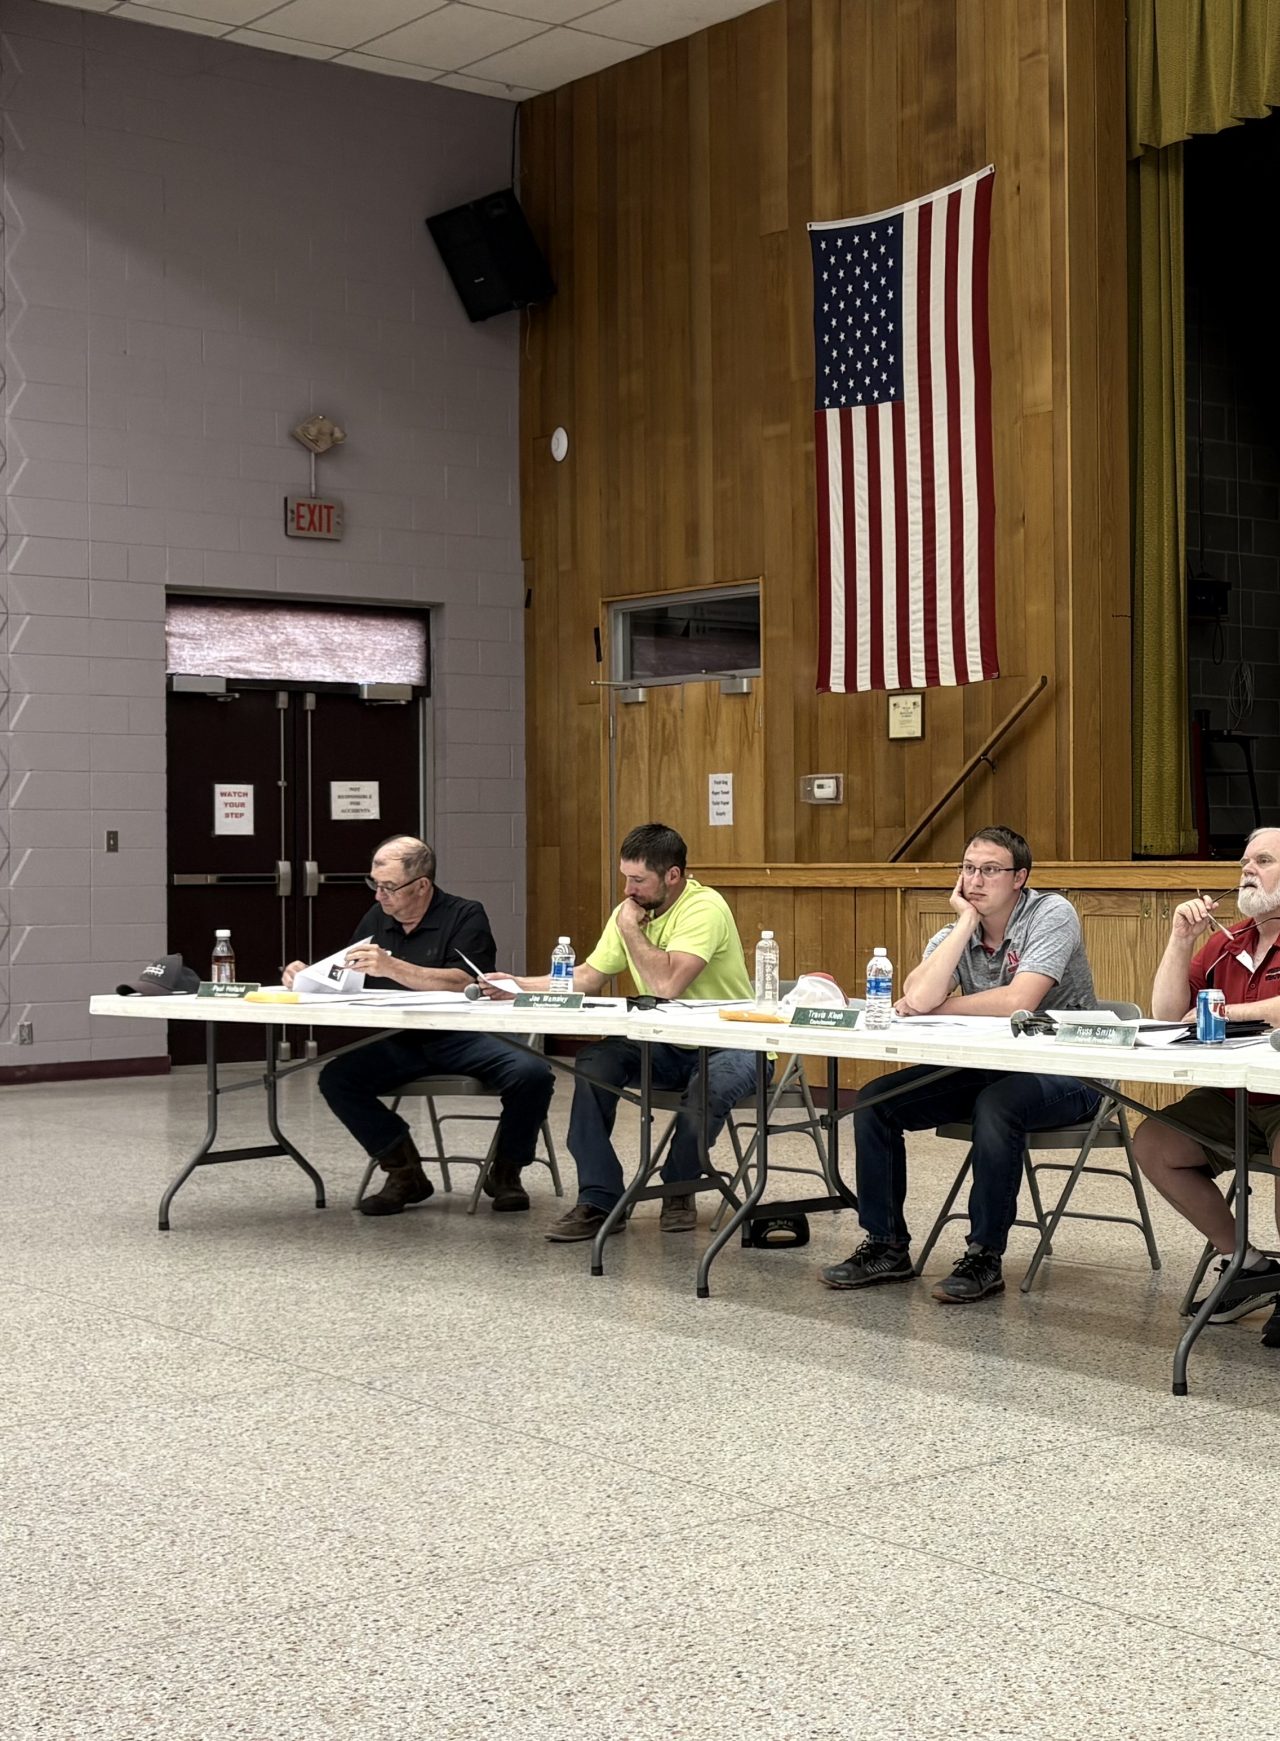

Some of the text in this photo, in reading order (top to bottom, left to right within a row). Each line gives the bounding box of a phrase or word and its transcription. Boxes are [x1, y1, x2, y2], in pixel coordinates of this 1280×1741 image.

[296, 503, 334, 533] EXIT
[808, 1010, 827, 1019] Travis
[1076, 1026, 1116, 1038] Russ Smith
